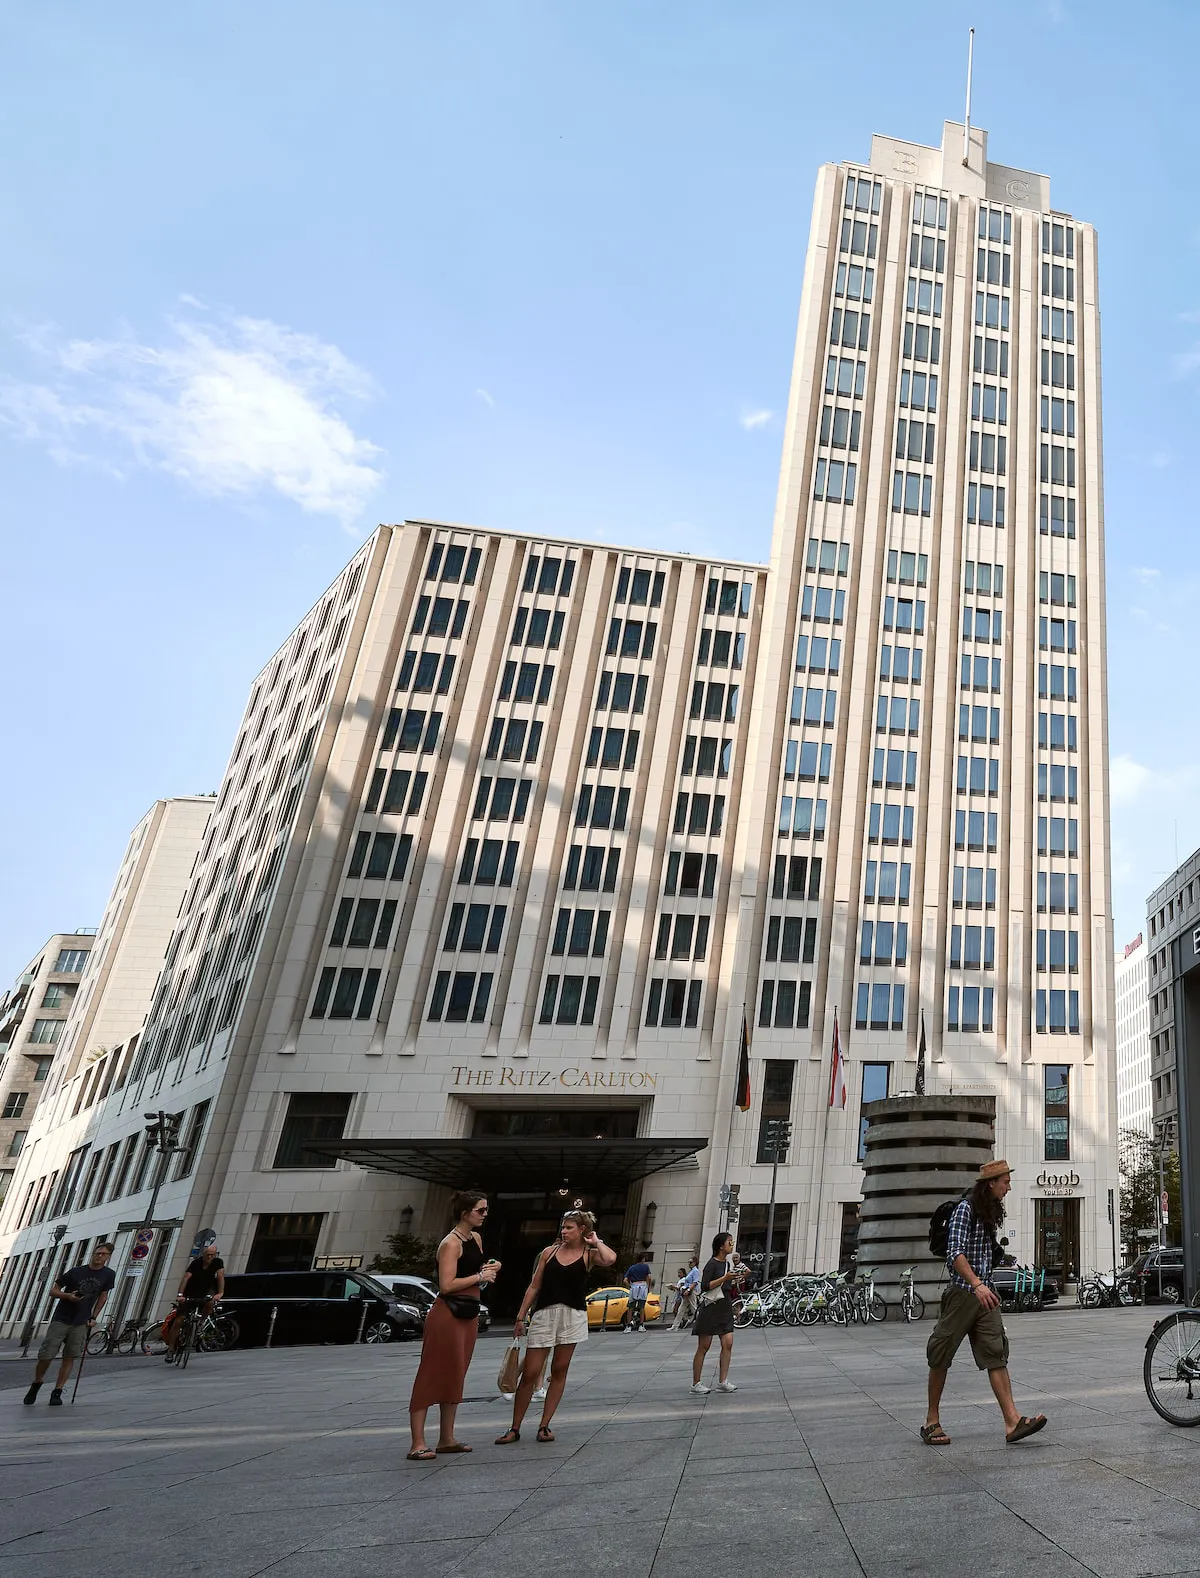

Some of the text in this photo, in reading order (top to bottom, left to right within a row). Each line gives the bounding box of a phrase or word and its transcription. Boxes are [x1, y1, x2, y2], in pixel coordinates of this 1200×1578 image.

[452, 1066, 659, 1088] THE RITZ-CARLTON
[1036, 1169, 1080, 1187] doob
[1043, 1188, 1056, 1197] You
[749, 1253, 774, 1262] POS
